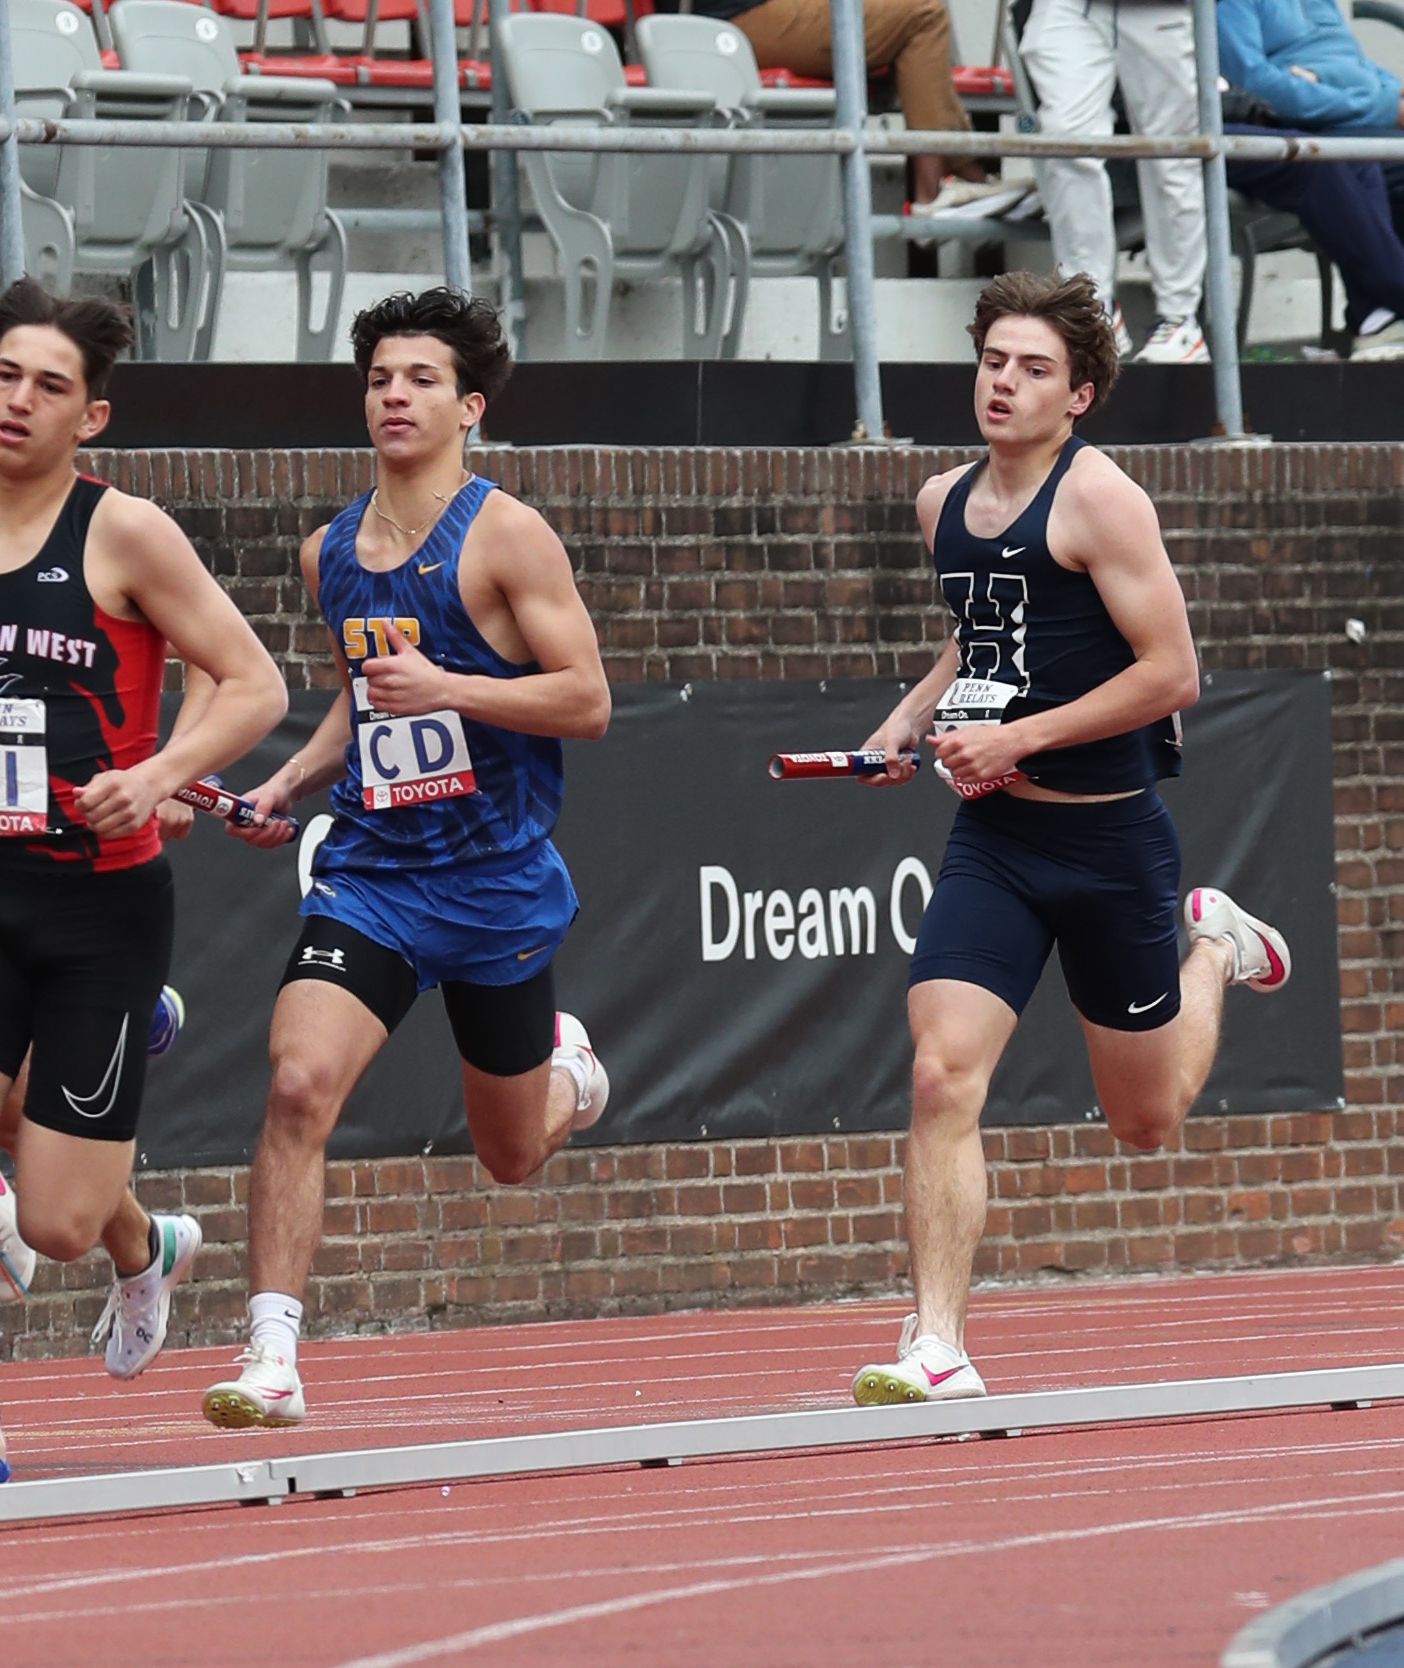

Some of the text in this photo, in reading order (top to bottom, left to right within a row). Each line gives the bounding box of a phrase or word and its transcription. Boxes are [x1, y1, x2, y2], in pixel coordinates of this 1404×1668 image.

[26, 628, 96, 668] WEST
[959, 693, 998, 703] RELAYS
[963, 682, 993, 693] PENN
[392, 777, 464, 802] TOYOTA
[699, 865, 878, 962] Dream
